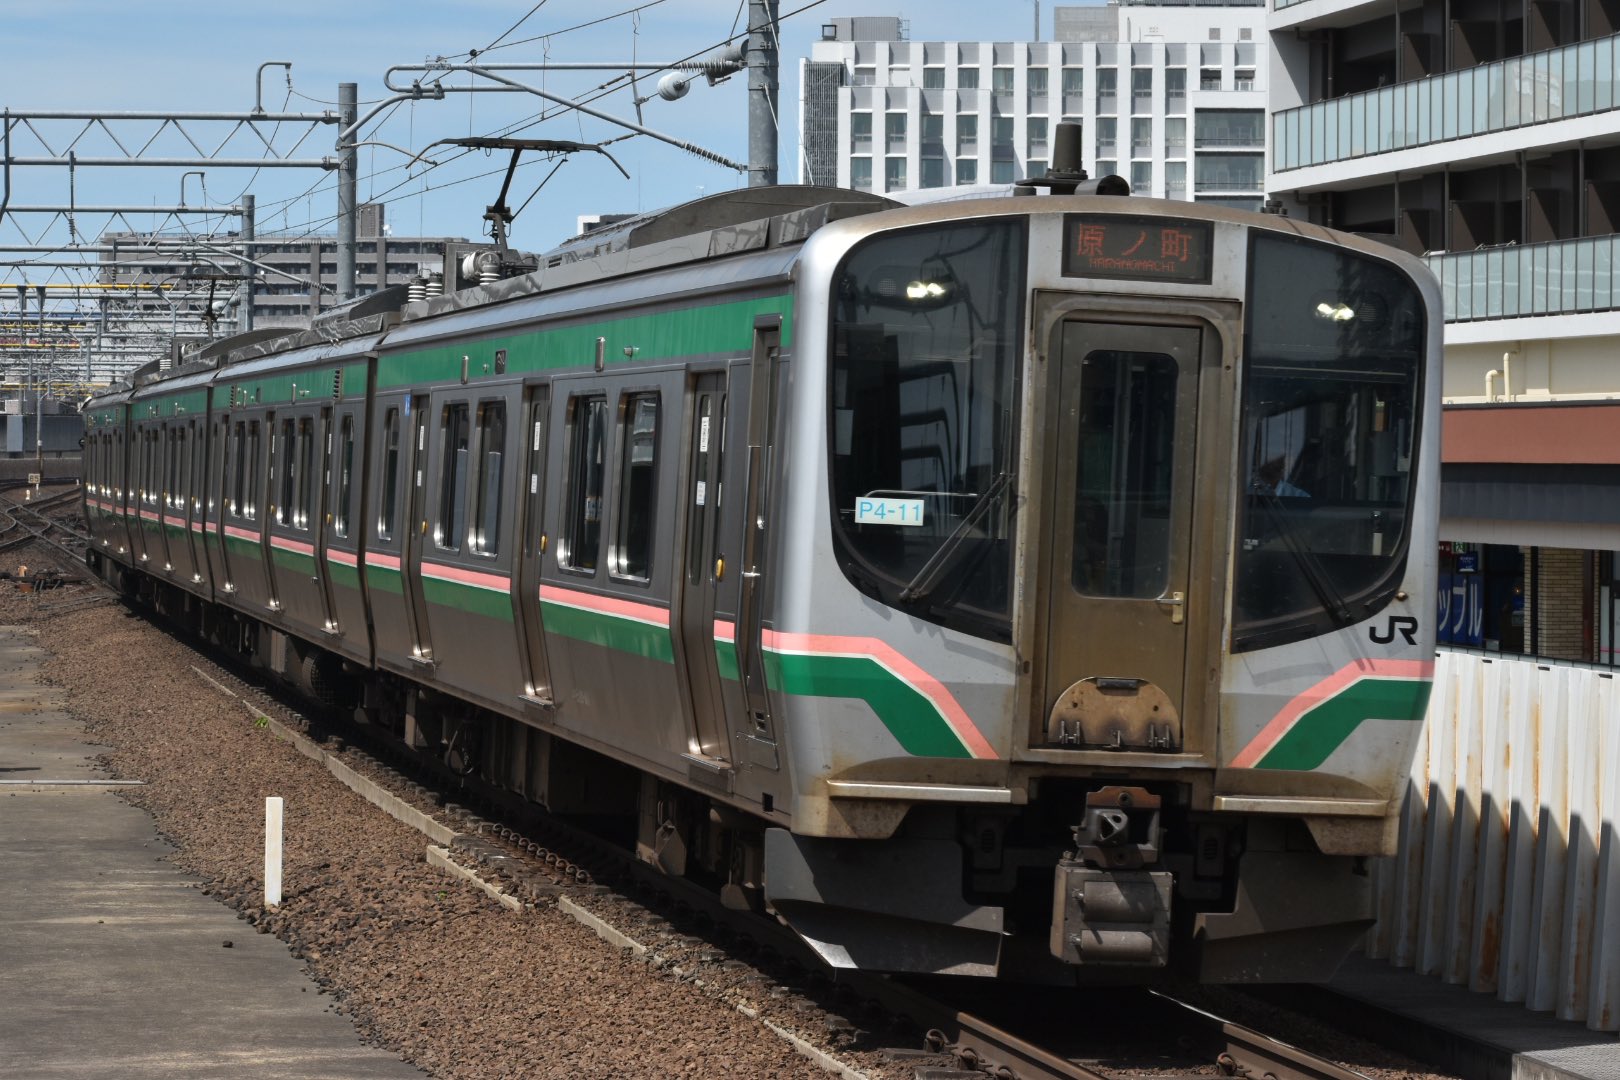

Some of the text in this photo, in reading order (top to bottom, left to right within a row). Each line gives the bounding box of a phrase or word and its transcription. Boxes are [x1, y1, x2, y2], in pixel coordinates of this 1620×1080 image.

[1077, 223, 1192, 262] 原ノ町
[1089, 257, 1176, 273] HARANOMACHI
[859, 501, 921, 521] P4-11
[1369, 615, 1418, 646] JR
